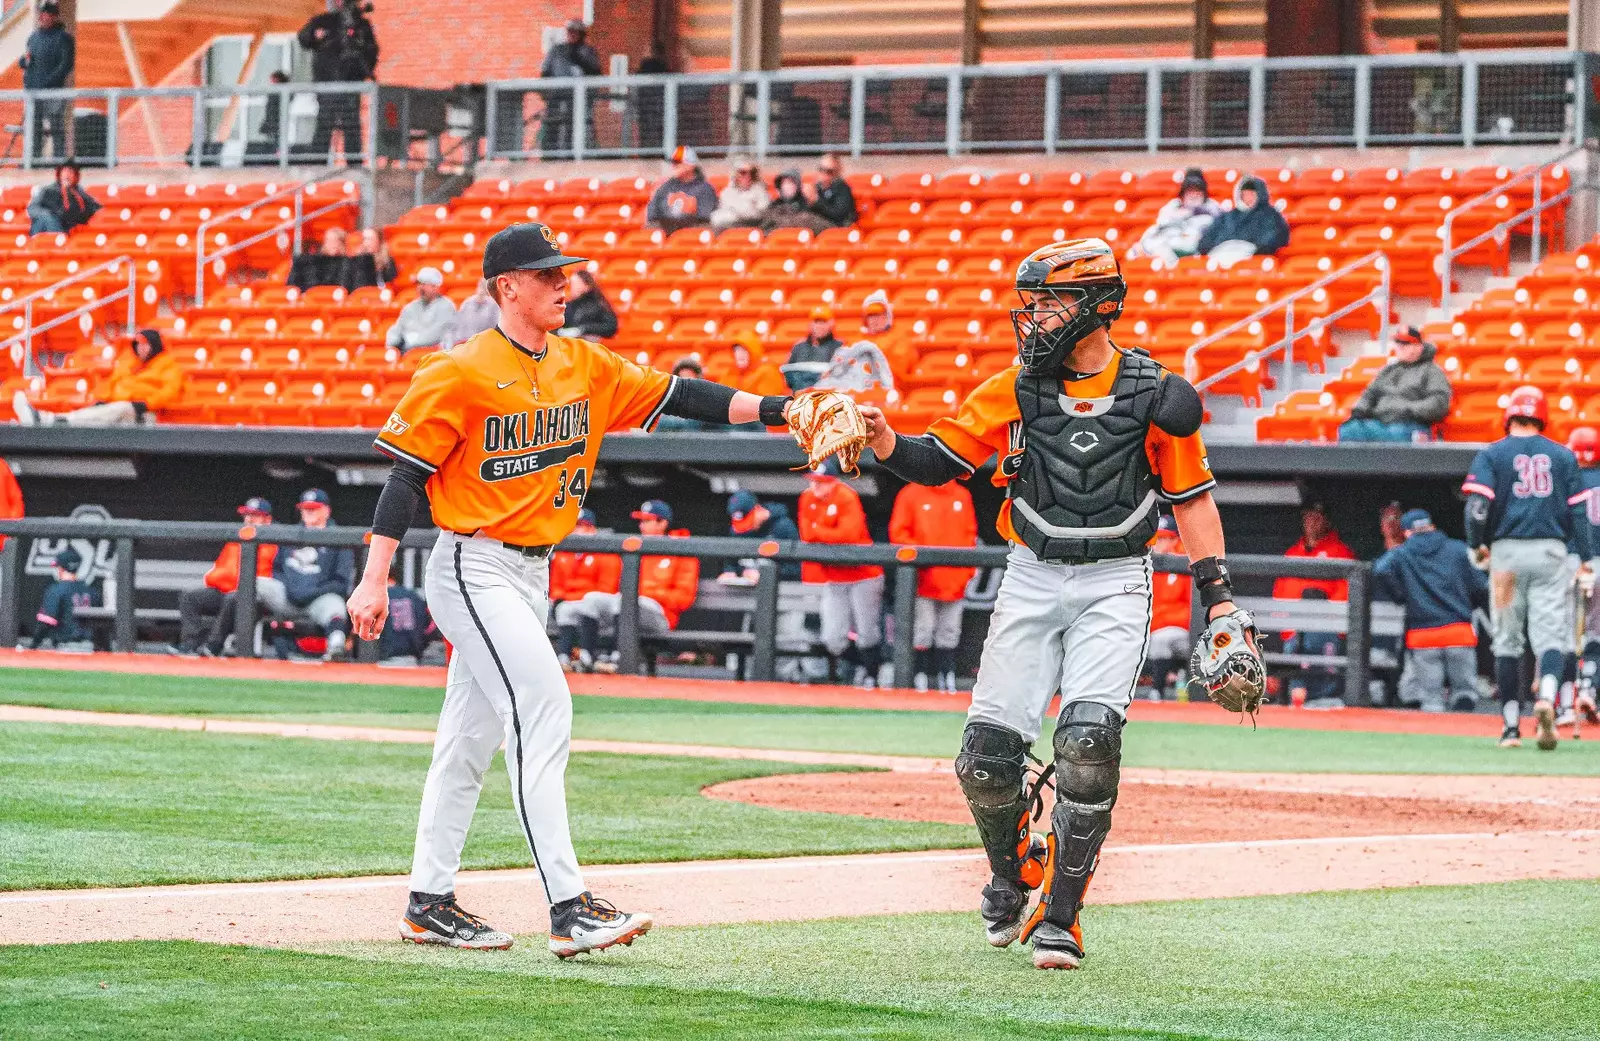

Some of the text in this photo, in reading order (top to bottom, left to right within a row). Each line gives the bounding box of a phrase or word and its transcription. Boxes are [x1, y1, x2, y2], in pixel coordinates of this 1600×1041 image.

[483, 399, 590, 454] OKLAHOMA
[493, 455, 539, 477] STATE
[1512, 453, 1554, 499] 36
[553, 468, 588, 509] 34
